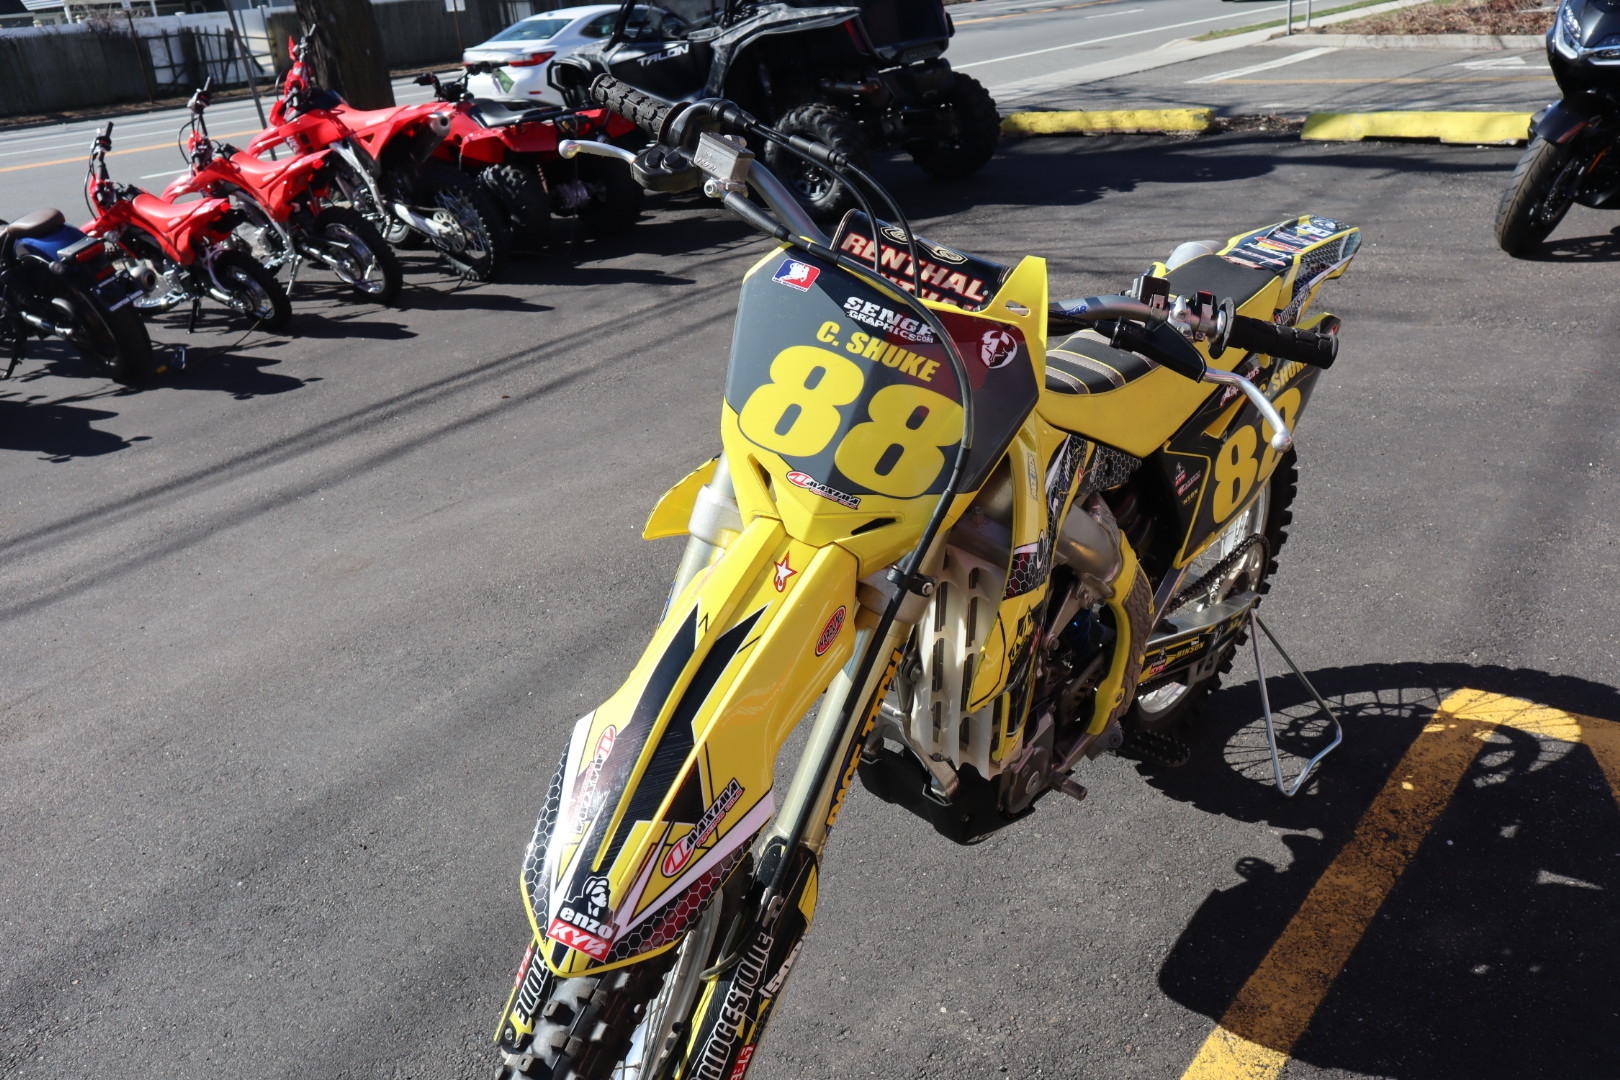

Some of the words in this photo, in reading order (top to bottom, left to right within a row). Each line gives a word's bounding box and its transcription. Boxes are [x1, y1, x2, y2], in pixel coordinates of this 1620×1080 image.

[637, 43, 689, 67] TALON
[840, 232, 985, 303] RENTHAL
[816, 321, 840, 347] C.
[845, 332, 941, 383] SHUKE
[737, 345, 964, 500] 88
[1176, 642, 1204, 659] HINSON
[686, 779, 741, 850] MAXIMA
[550, 922, 607, 955] KYB
[559, 907, 614, 939] enzo
[689, 931, 775, 1080] RIDGESTONE
